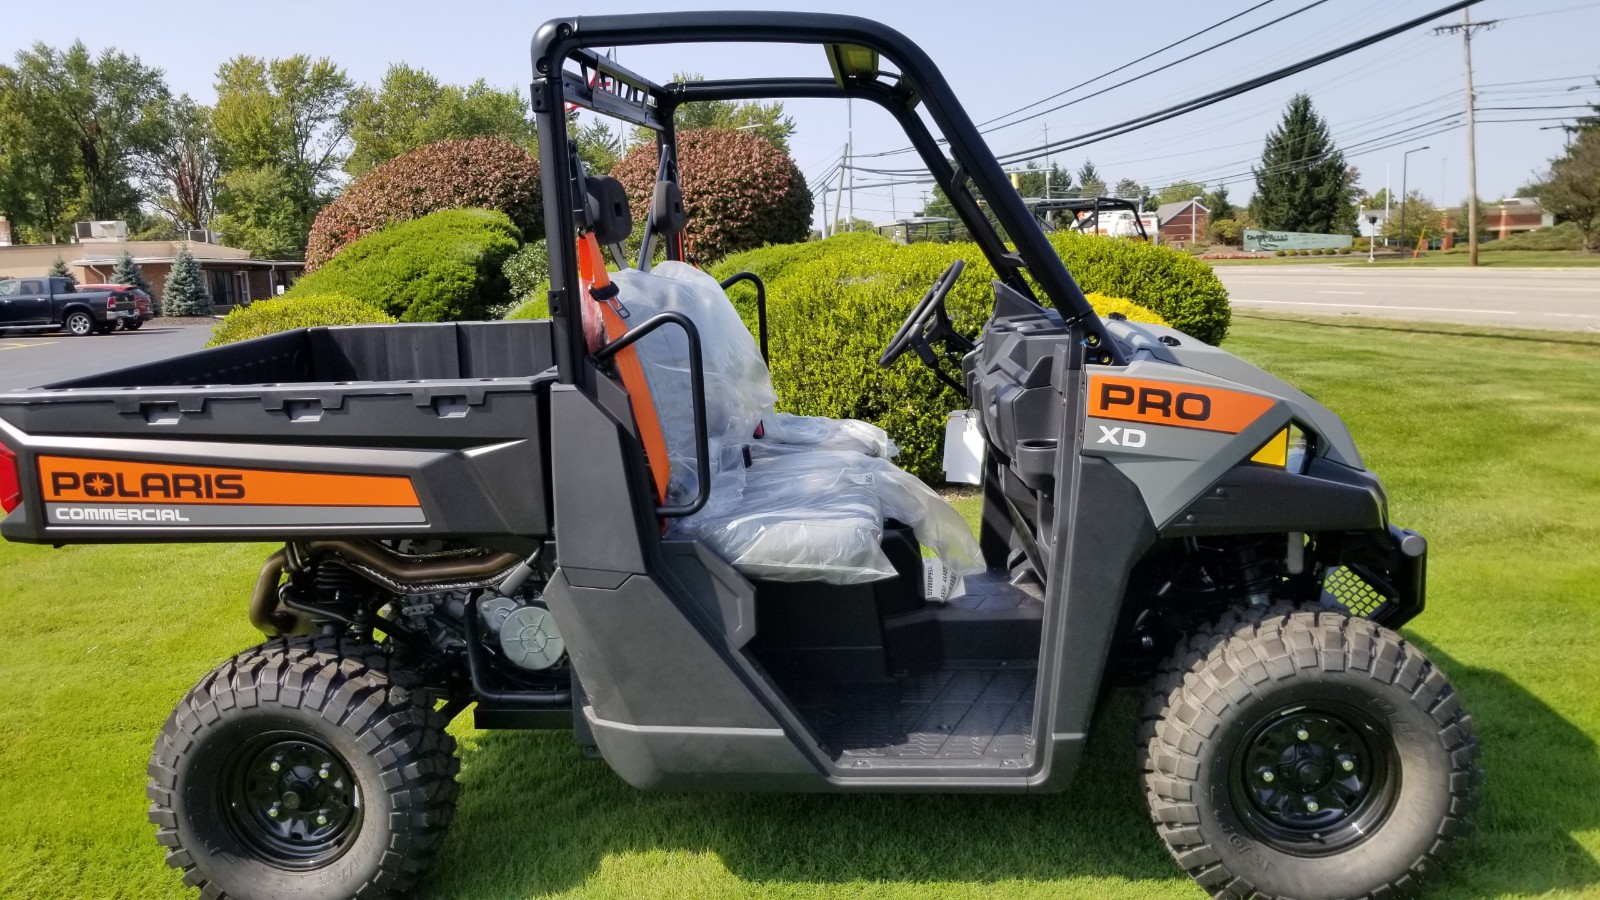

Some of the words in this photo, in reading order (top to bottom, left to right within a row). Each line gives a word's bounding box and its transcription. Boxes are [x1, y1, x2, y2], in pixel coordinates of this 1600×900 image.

[1100, 383, 1211, 421] PRO
[1097, 425, 1147, 448] XD
[51, 471, 246, 499] POLARIS
[55, 507, 190, 522] COMMERCIAL
